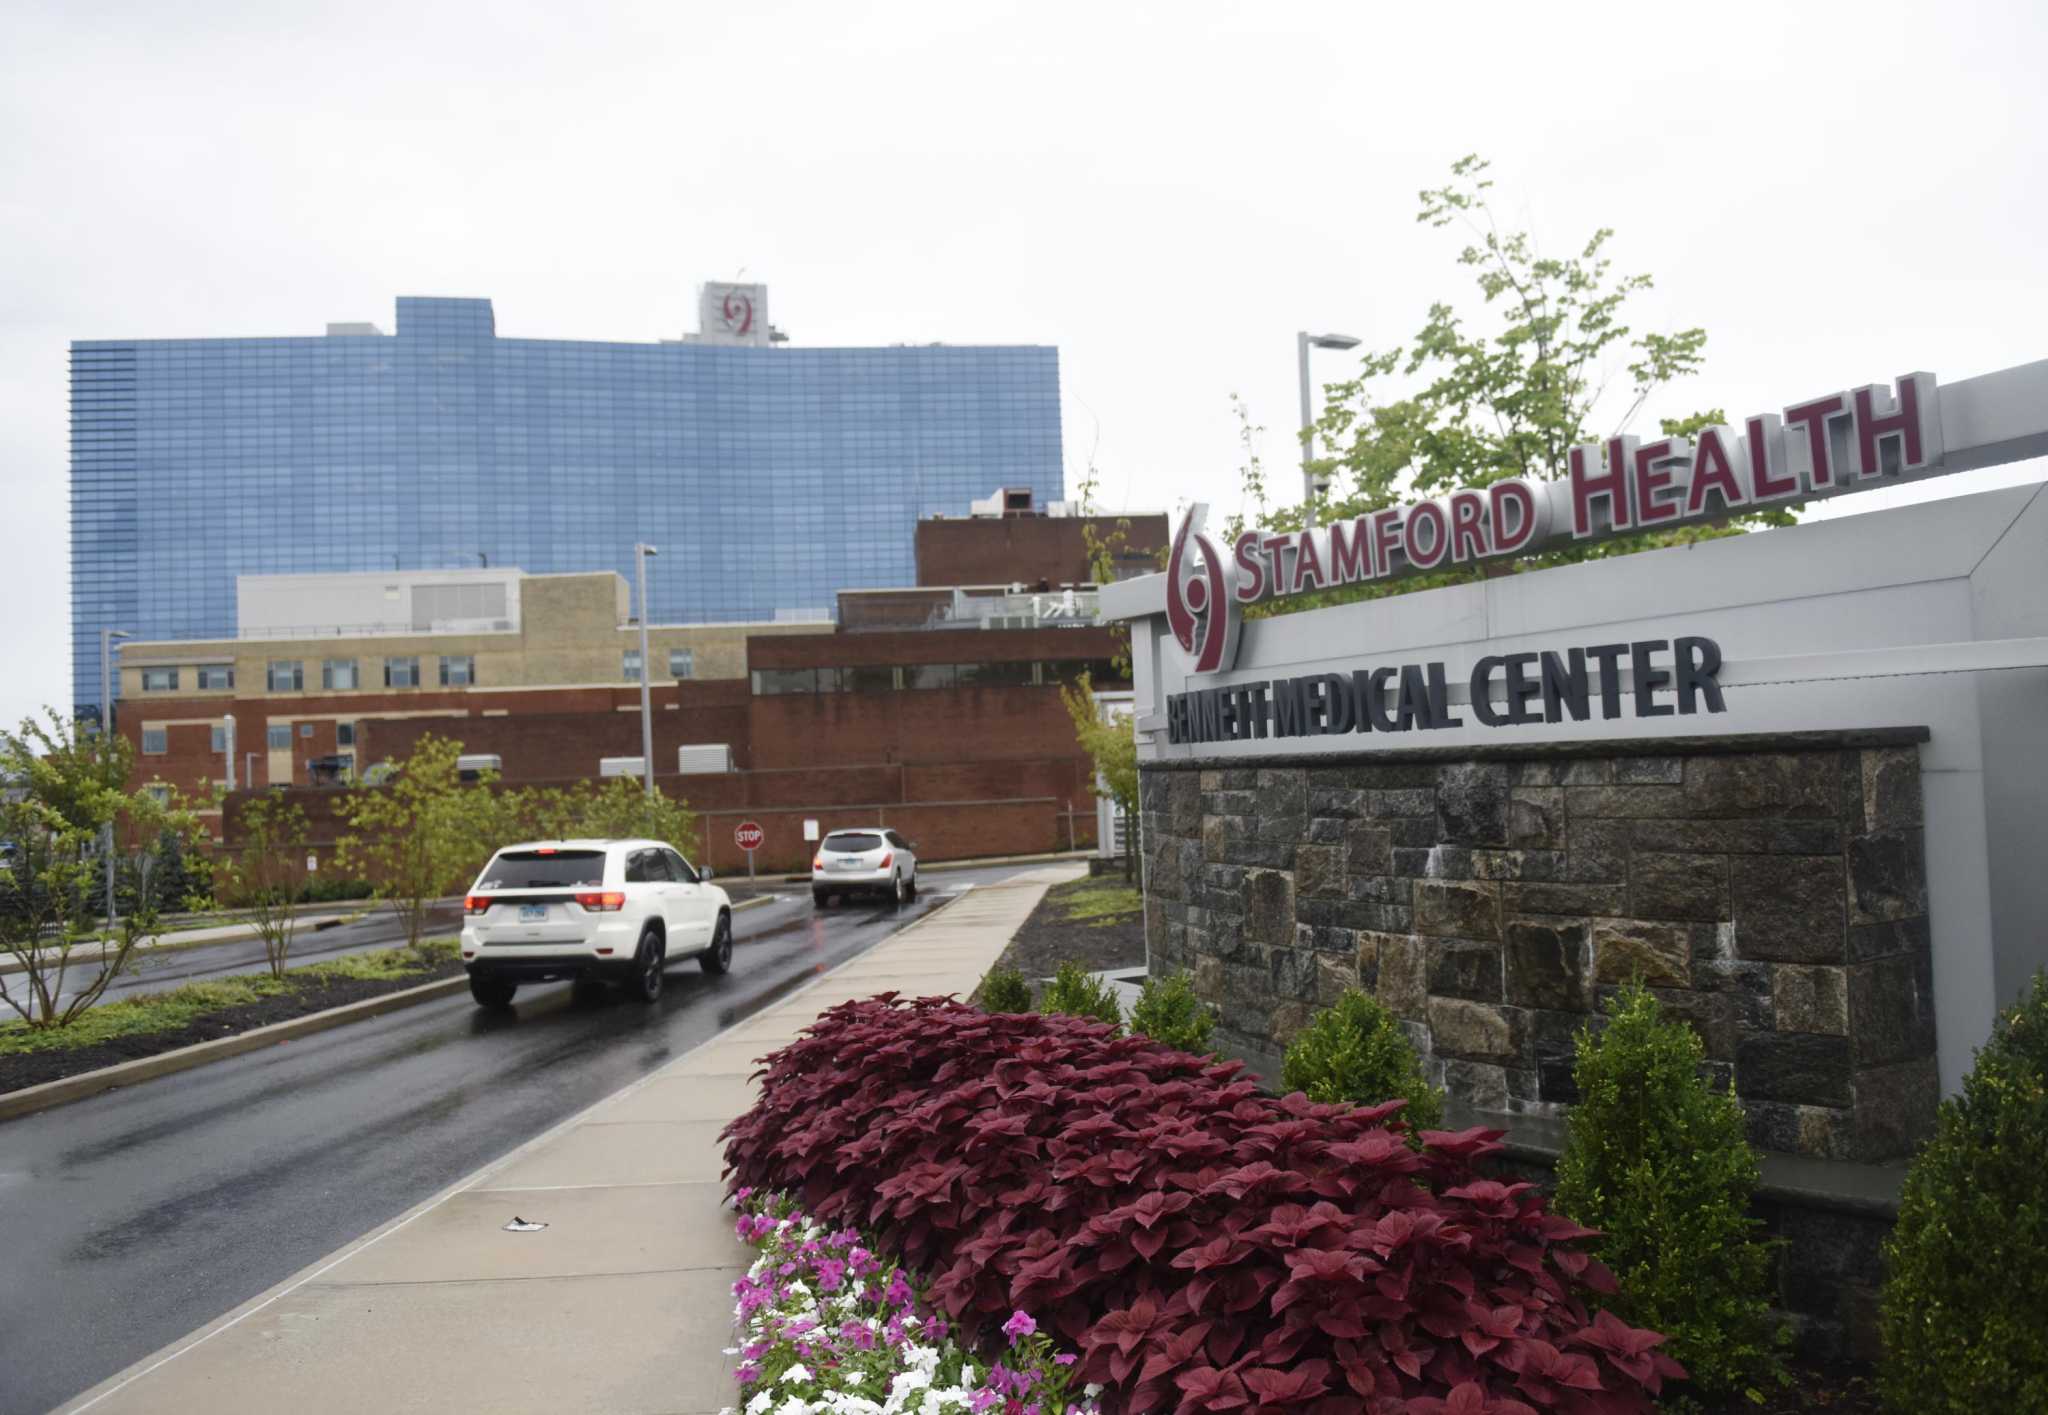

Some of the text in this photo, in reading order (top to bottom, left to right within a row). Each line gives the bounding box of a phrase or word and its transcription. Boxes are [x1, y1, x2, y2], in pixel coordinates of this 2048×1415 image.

[1234, 372, 1930, 603] STAMFORD HEALTH
[1167, 636, 1727, 745] BENNETT MEDICAL CENTER
[736, 830, 761, 842] STOP
